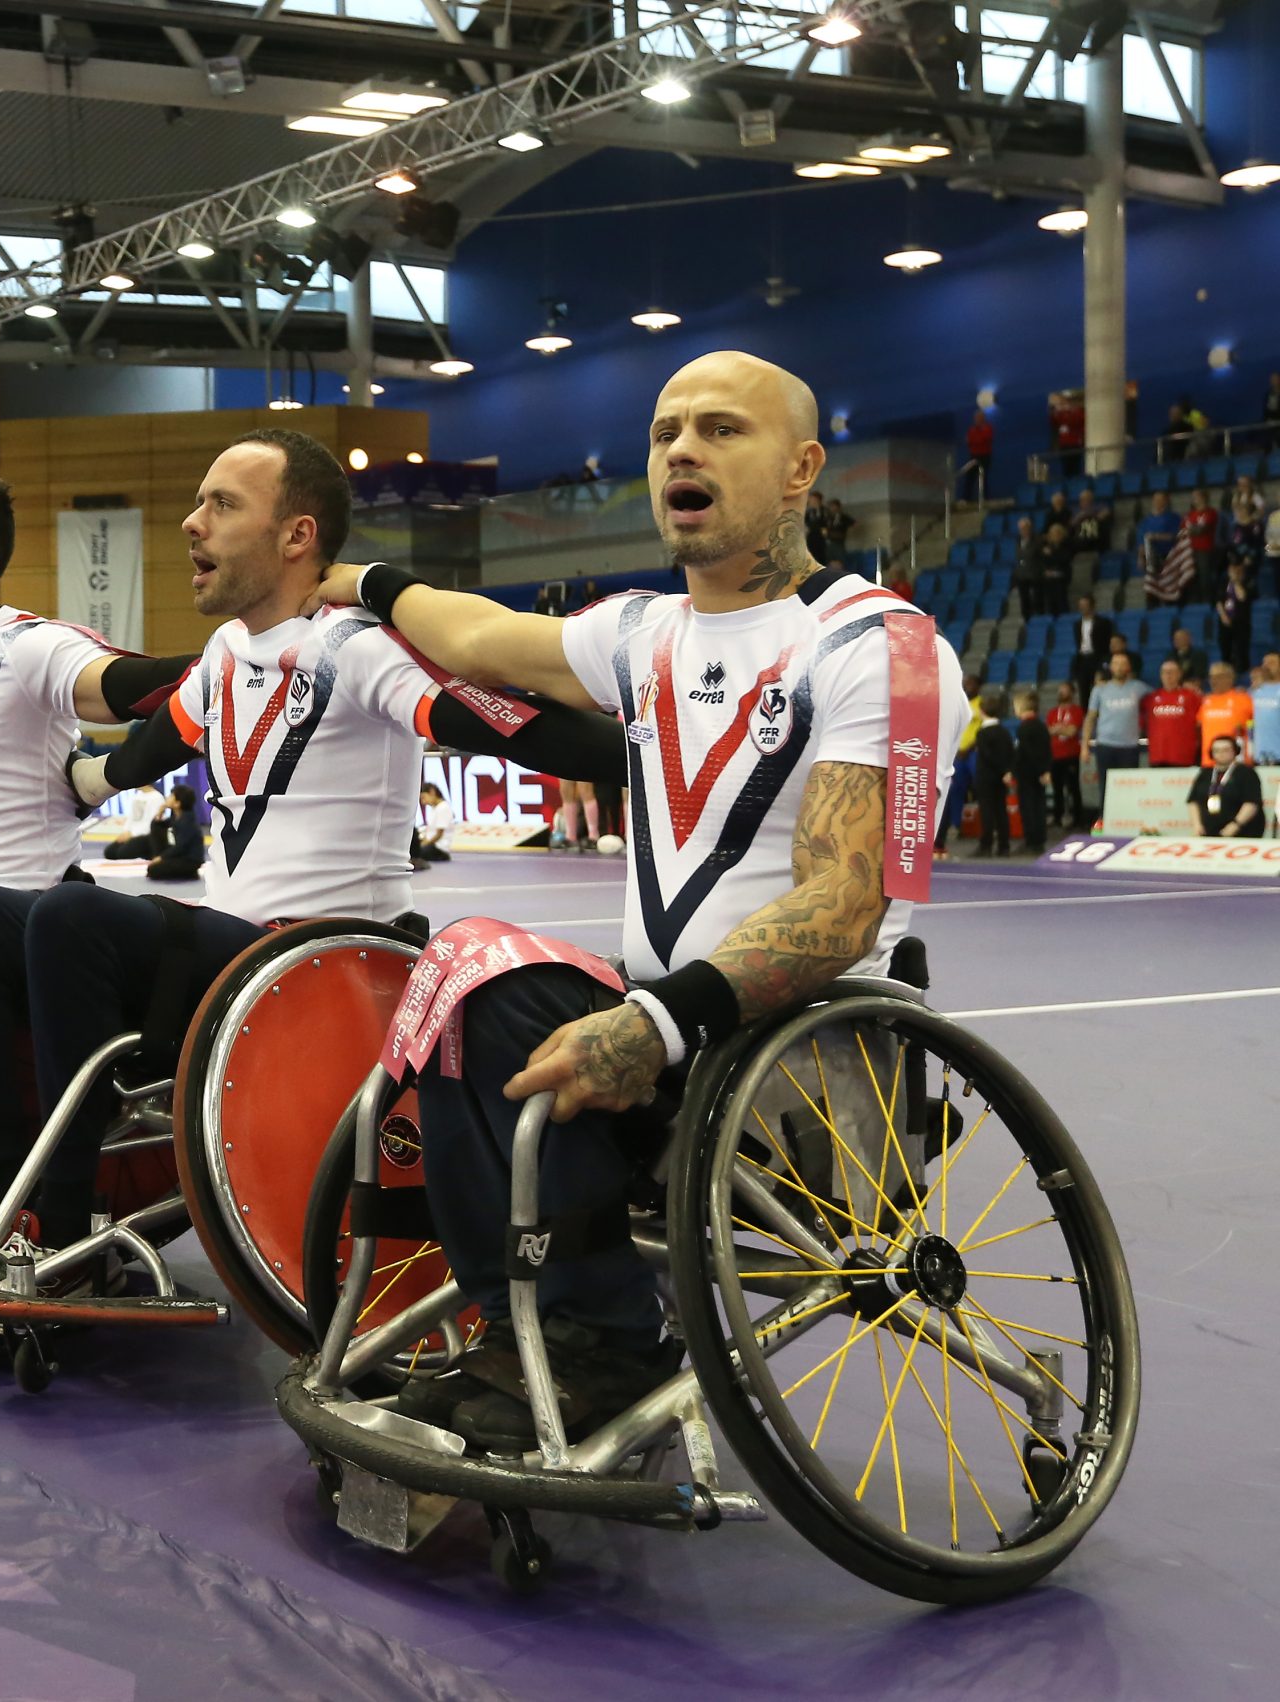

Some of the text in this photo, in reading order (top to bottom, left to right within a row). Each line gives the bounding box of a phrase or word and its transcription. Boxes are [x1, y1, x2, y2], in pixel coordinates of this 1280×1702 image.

[463, 684, 523, 725] WORLD CUP
[758, 727, 780, 737] FFR
[760, 737, 776, 745] XIII
[415, 755, 544, 828] NCE
[894, 765, 903, 807] ENGLAND
[917, 768, 928, 843] RUGBY LEAGUE
[899, 766, 919, 874] WORLD CUP
[392, 961, 438, 1059] WORLD CUP
